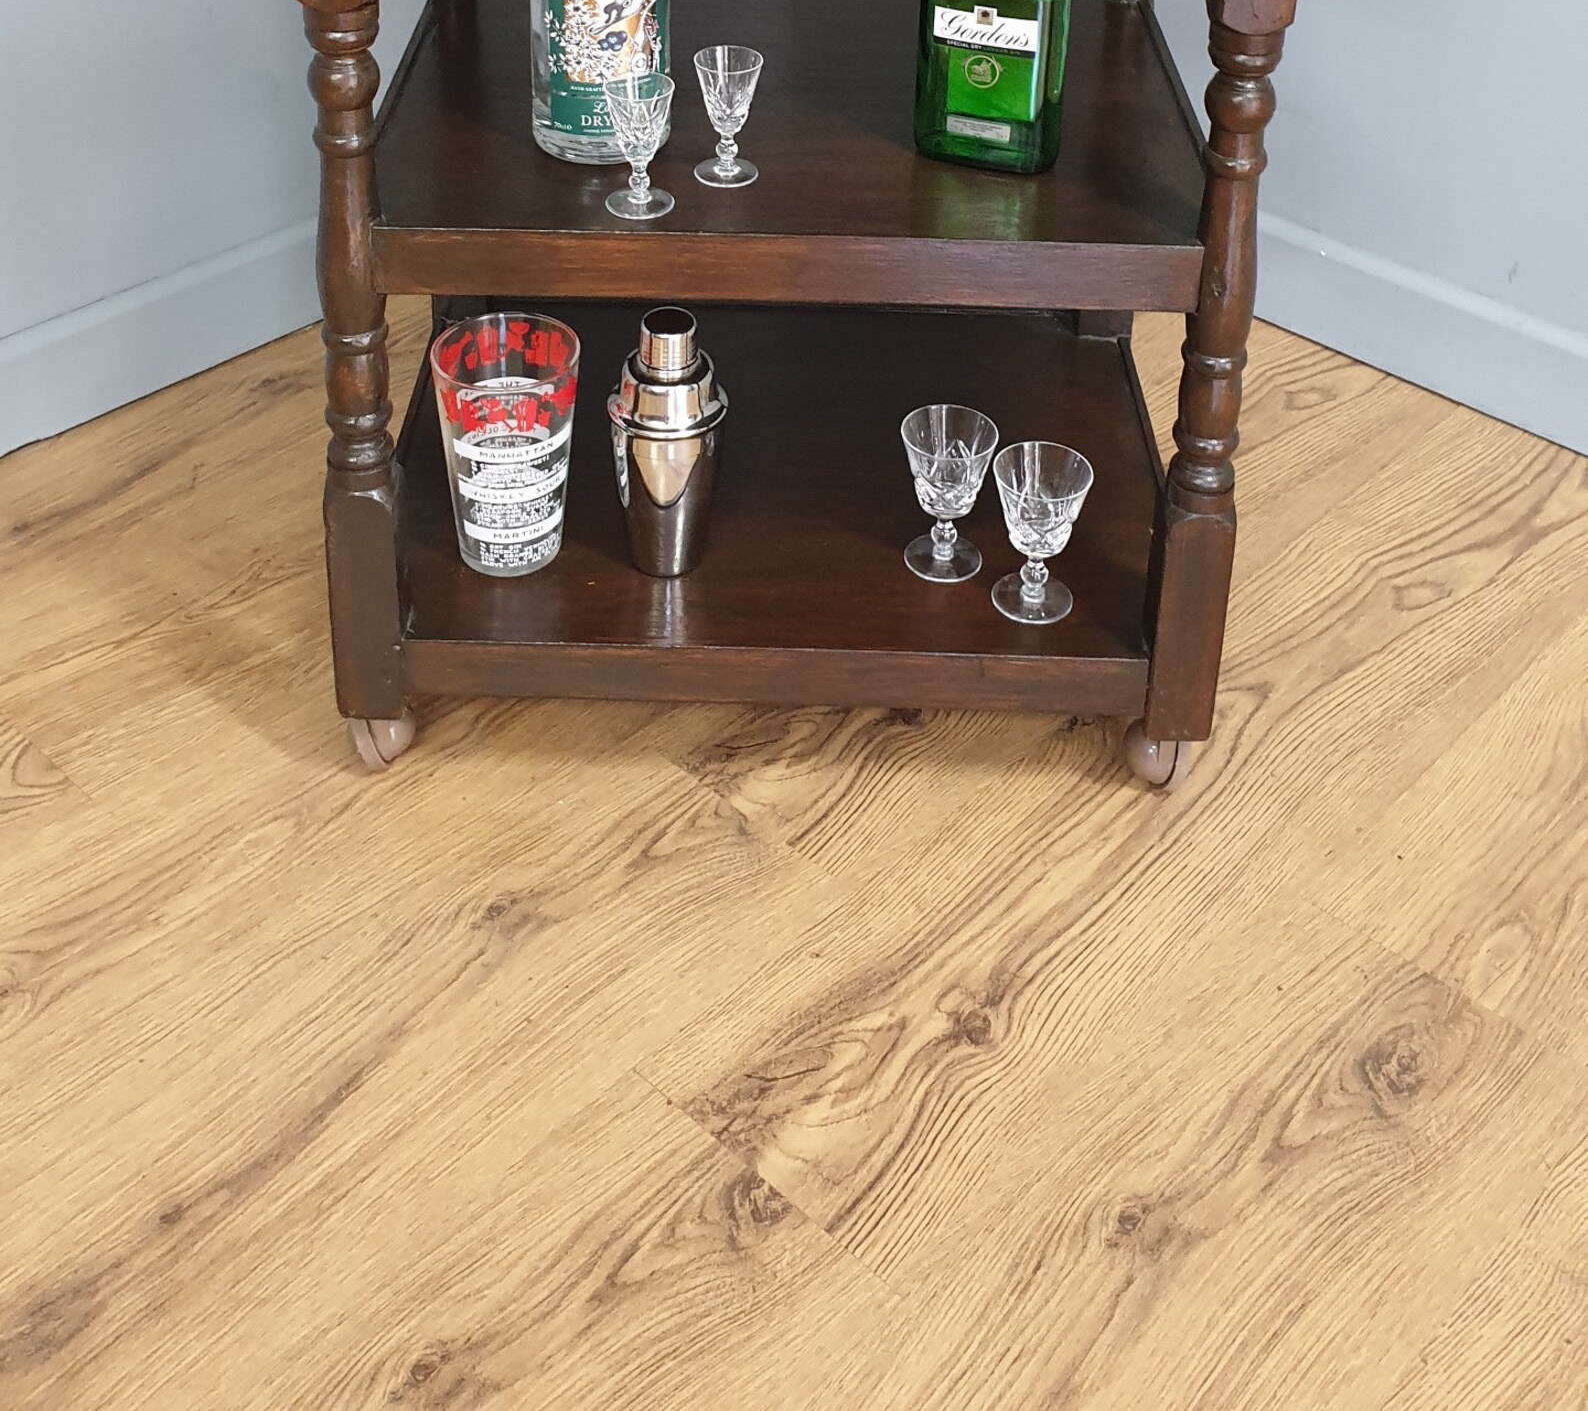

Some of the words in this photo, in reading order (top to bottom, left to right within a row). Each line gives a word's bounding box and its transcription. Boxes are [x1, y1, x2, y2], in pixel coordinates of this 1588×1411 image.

[940, 11, 1029, 47] Gordon's
[581, 114, 612, 127] DRY
[479, 441, 554, 459] MANHATTAN
[535, 476, 560, 493] SOUR
[493, 525, 544, 539] MARTINI
